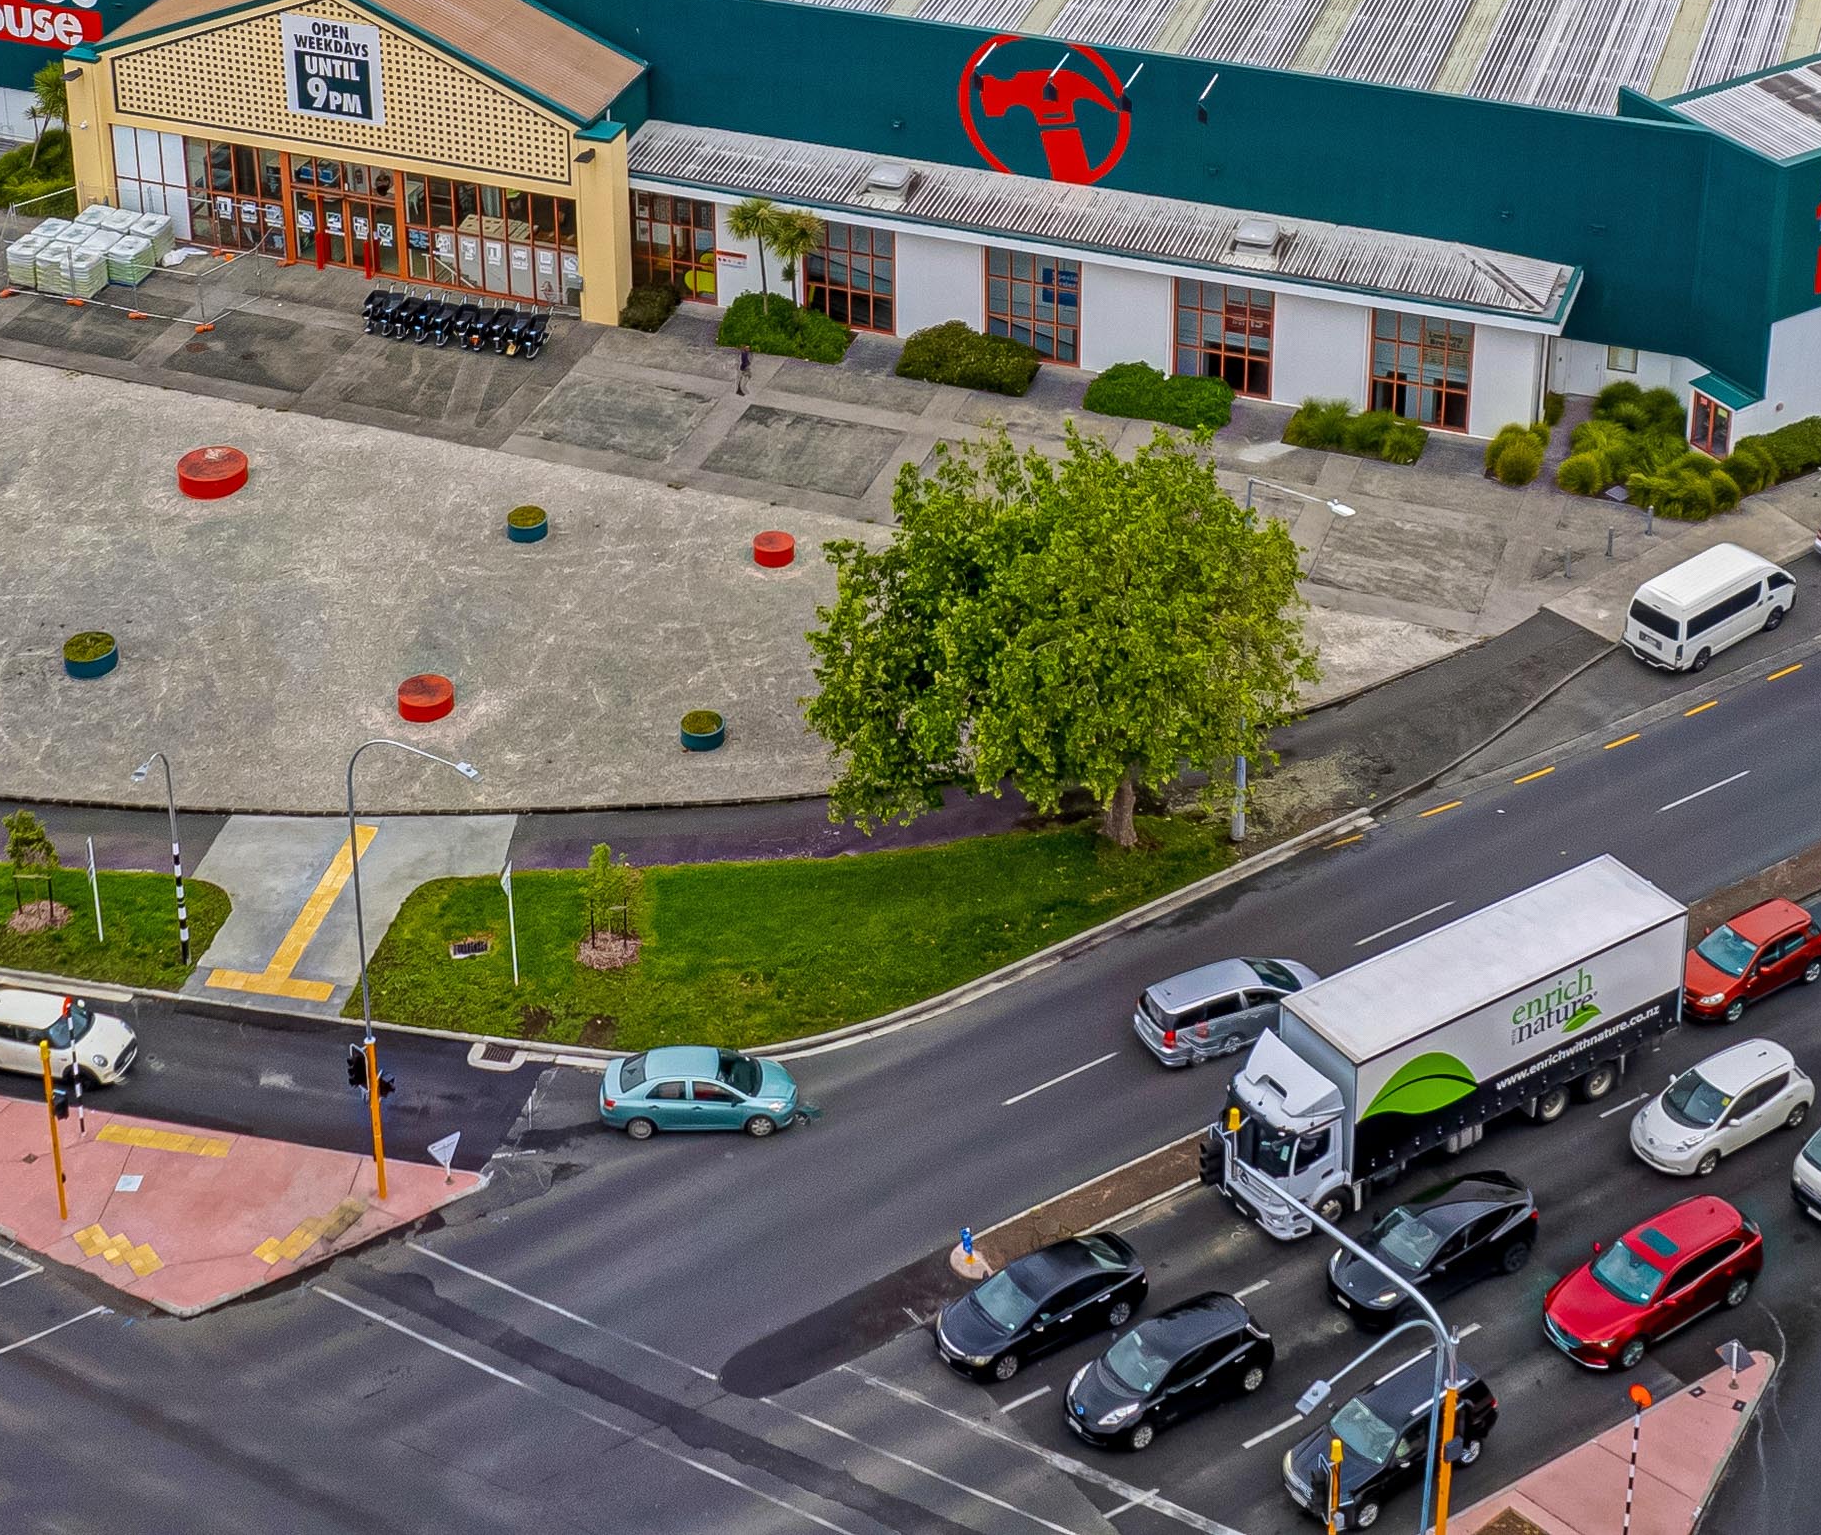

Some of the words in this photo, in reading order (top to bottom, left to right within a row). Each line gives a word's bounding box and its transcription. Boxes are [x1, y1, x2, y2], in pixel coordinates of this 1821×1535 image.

[294, 34, 369, 57] WEEKDAYS
[312, 21, 349, 41] OPEN
[304, 55, 360, 82] UNTIL
[1512, 968, 1593, 1025] enrich
[1517, 994, 1593, 1044] nature
[1495, 1005, 1660, 1091] www.enrichwithnature.co.nz
